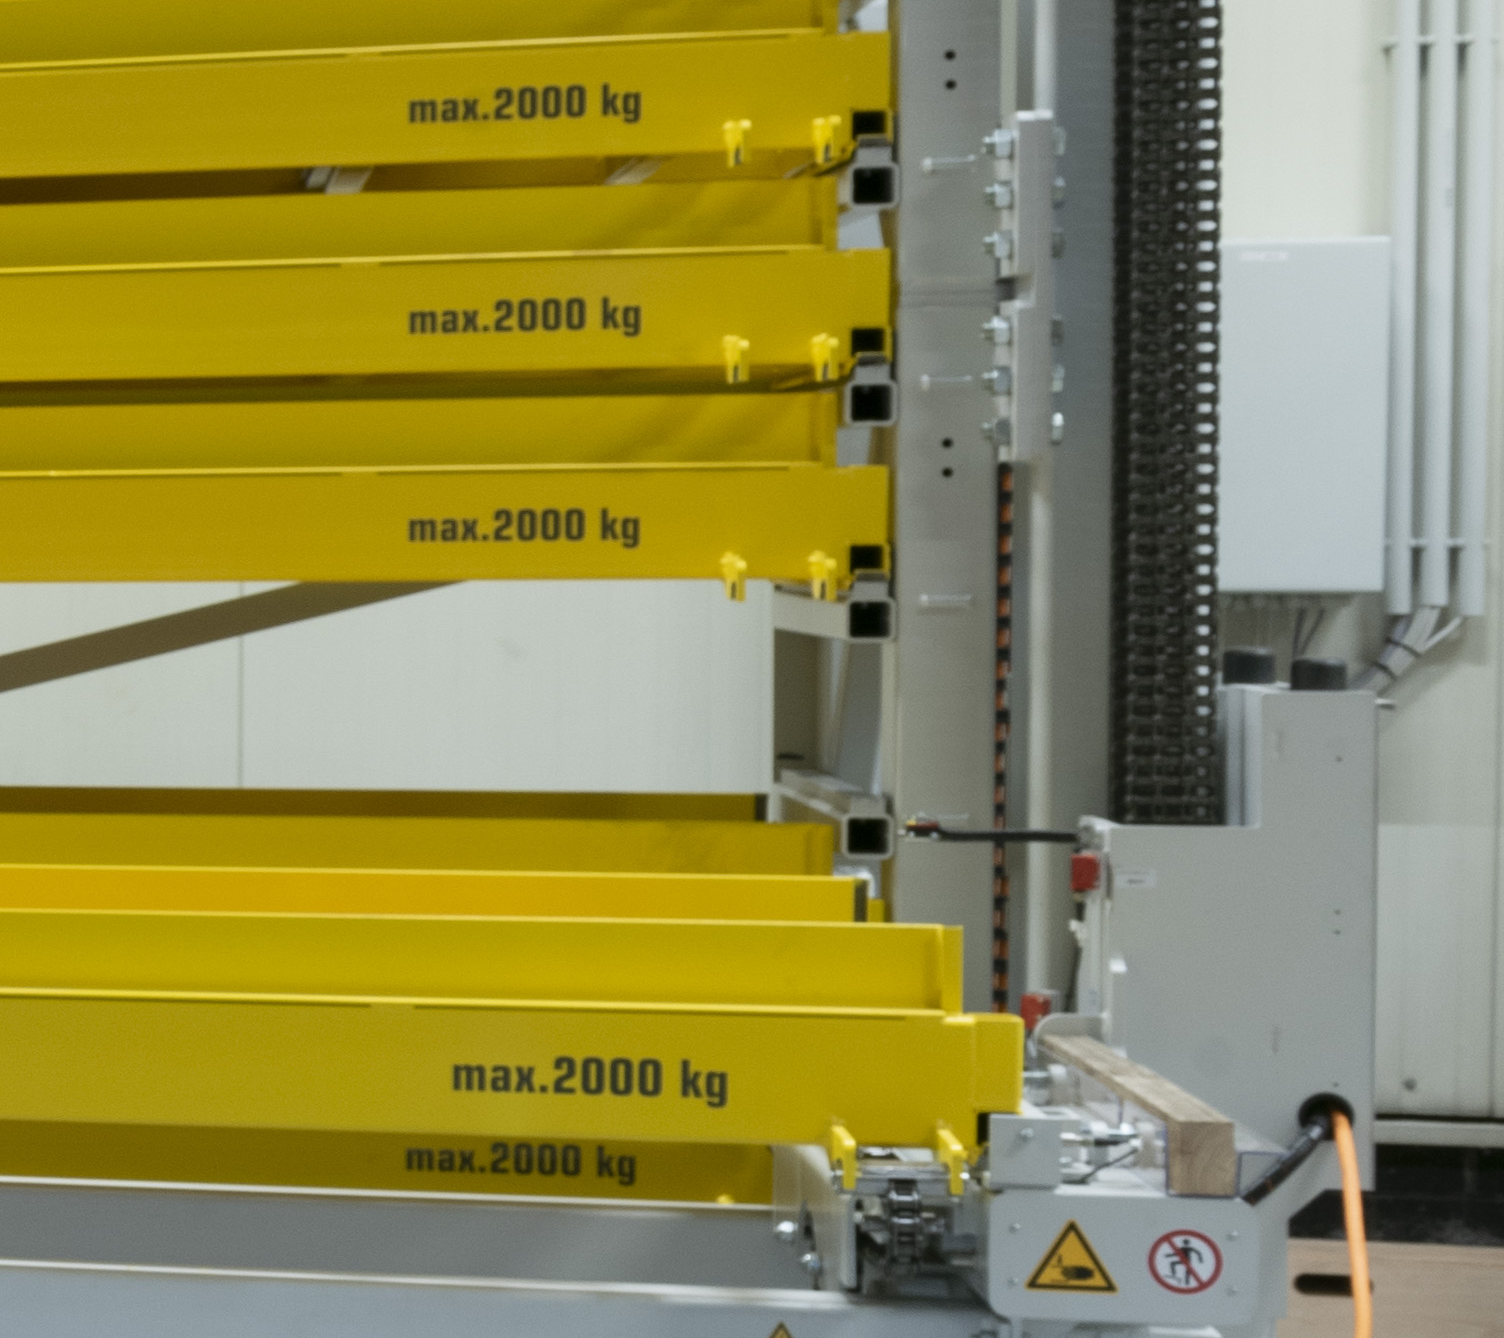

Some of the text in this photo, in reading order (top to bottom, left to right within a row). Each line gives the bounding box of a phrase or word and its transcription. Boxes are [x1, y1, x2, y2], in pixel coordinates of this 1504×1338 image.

[409, 84, 641, 123] max.2000 kg
[409, 297, 640, 337] max.2000 kg
[409, 508, 639, 548] max.2000 kg
[452, 1056, 727, 1108] max.2000 kg
[406, 1142, 636, 1186] max.2000 kg
